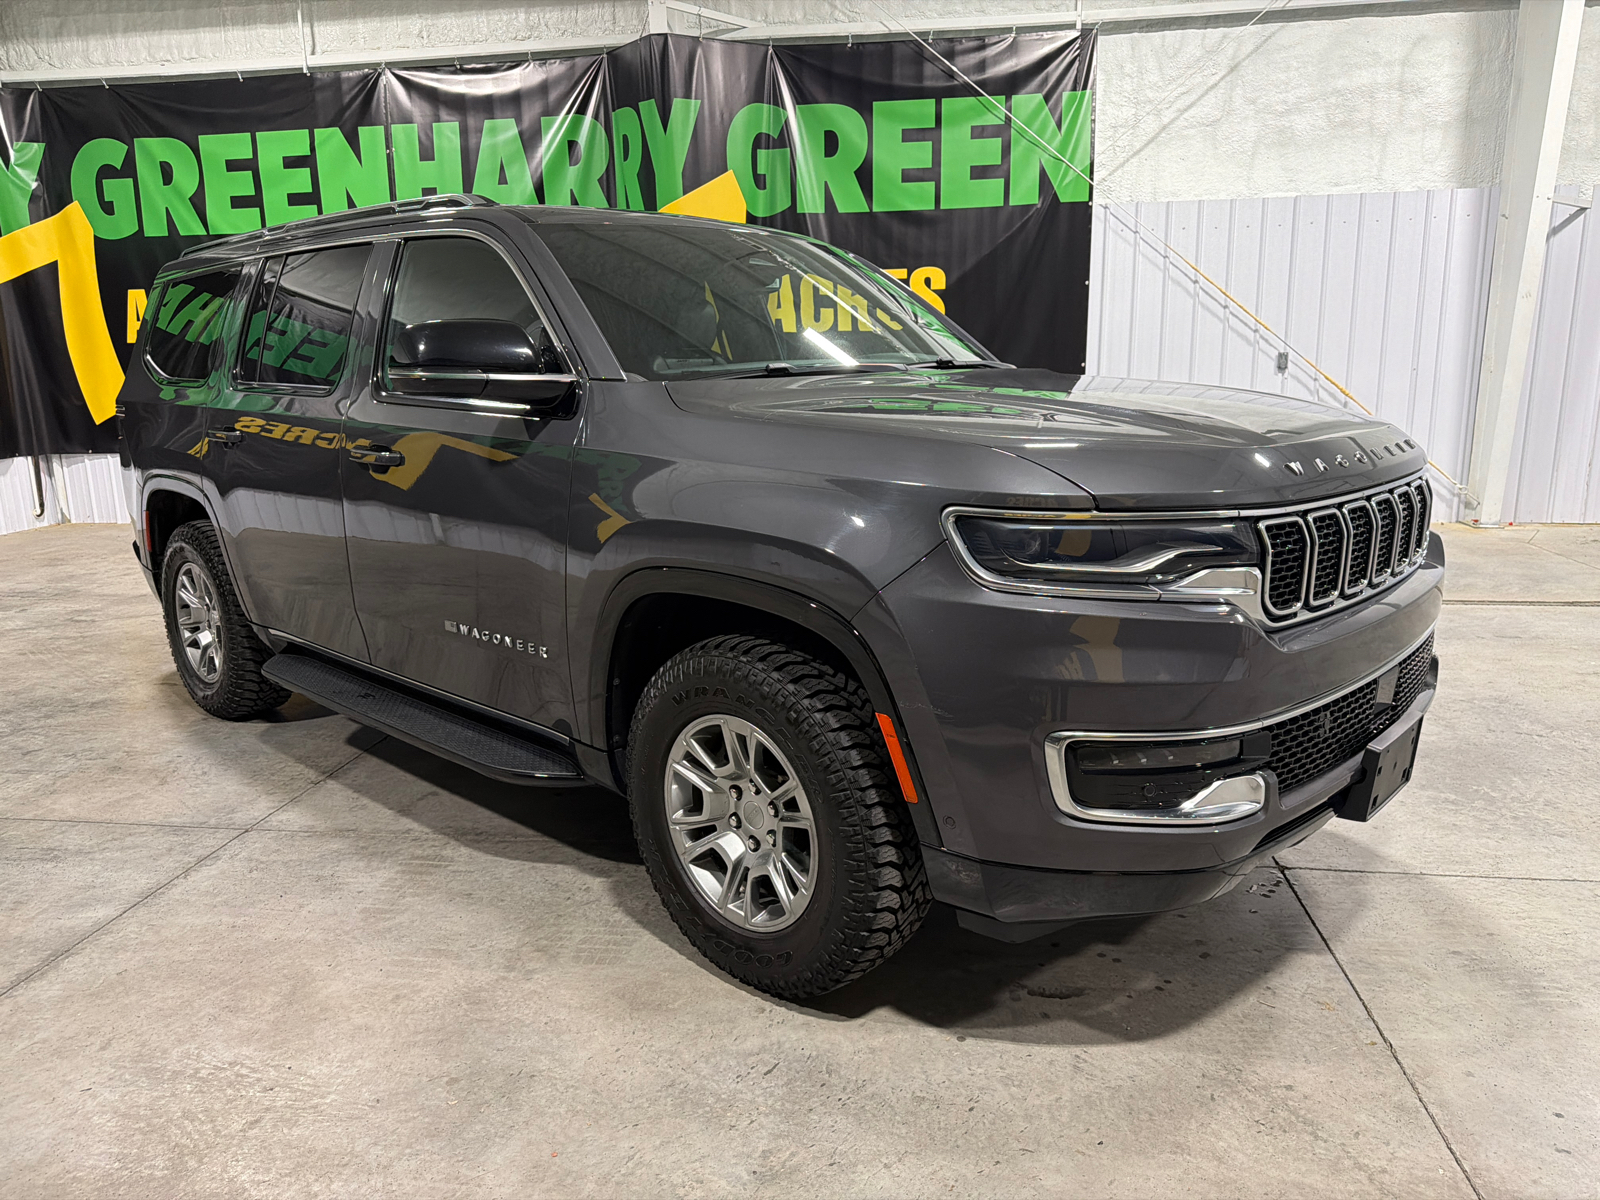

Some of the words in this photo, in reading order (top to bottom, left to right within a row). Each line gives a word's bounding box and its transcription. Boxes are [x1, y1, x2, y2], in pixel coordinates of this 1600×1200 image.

[70, 125, 390, 240] GREEN
[391, 97, 701, 213] HARRY
[726, 90, 1093, 218] GREEN
[1283, 439, 1416, 476] WAGONEER
[459, 623, 548, 658] WAGONEER
